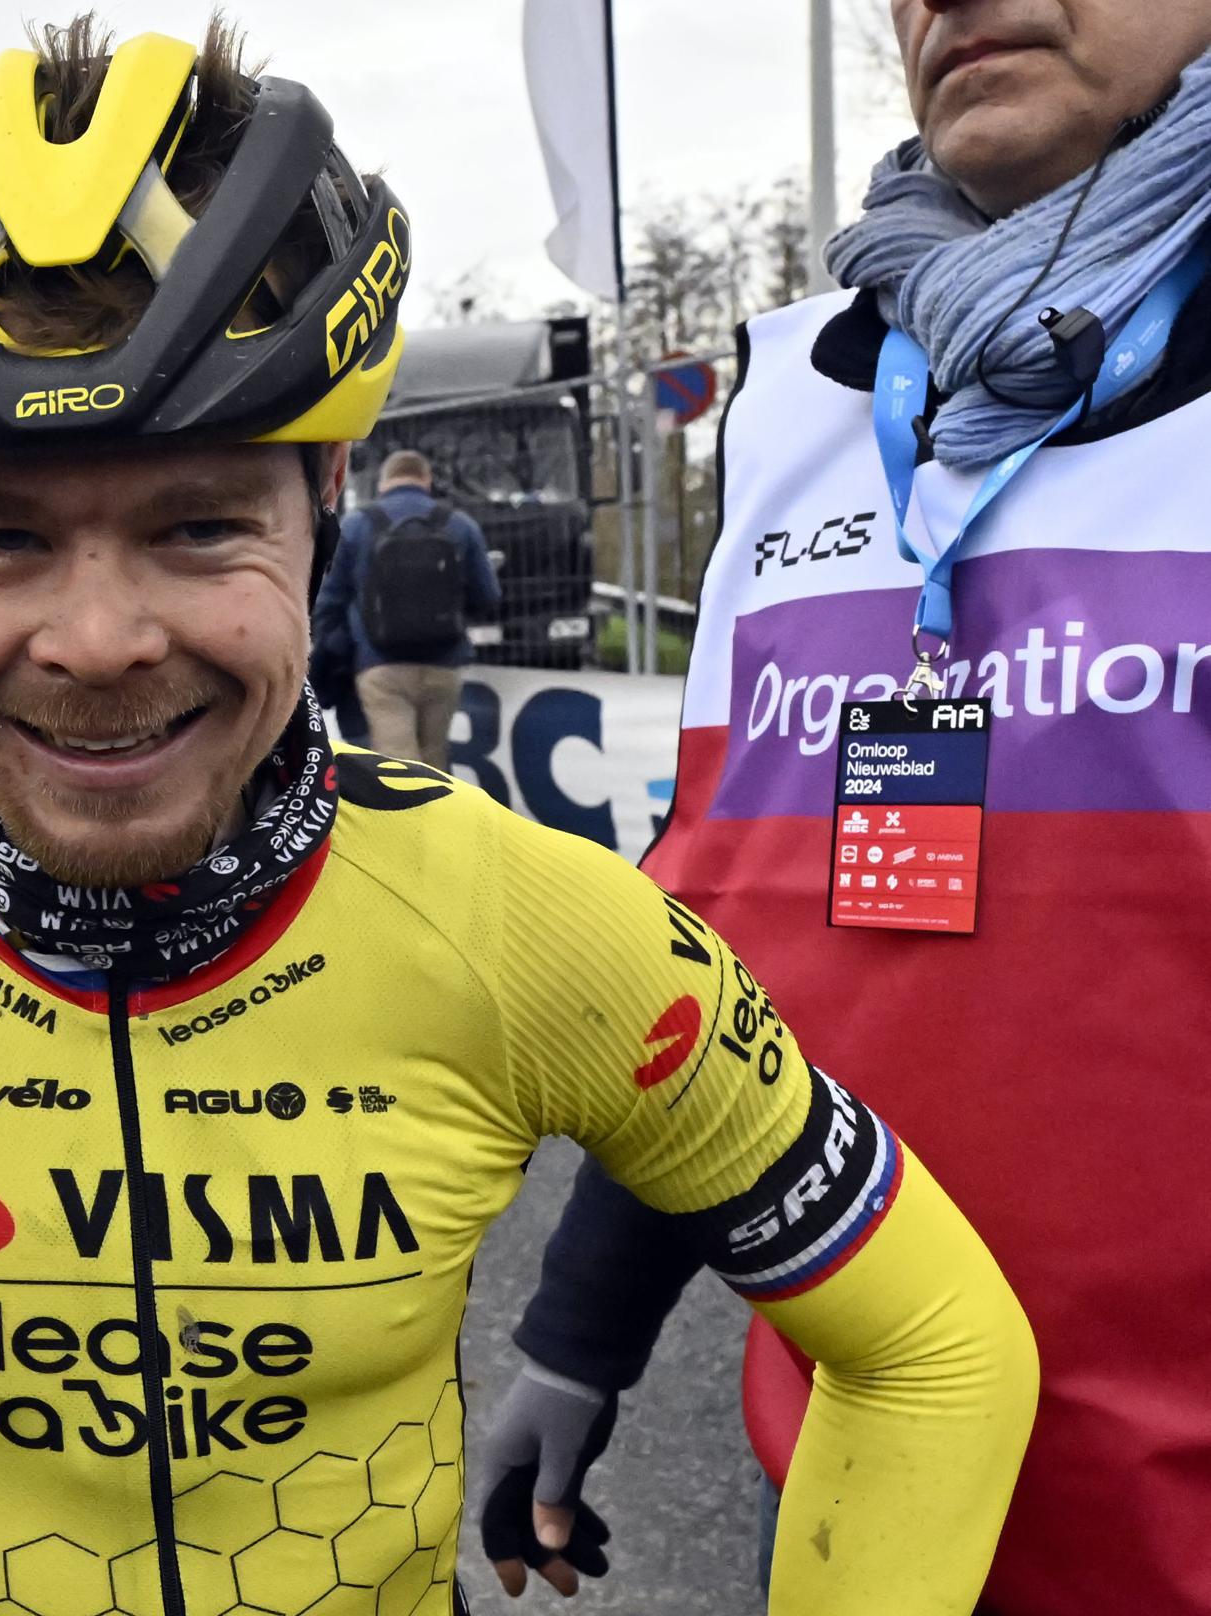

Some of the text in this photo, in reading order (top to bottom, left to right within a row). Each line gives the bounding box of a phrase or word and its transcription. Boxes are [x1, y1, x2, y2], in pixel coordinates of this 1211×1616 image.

[325, 207, 412, 378] GIRO
[16, 383, 125, 418] GIRO
[755, 511, 877, 577] FLCS
[932, 704, 984, 729] AA
[446, 680, 619, 851] BC
[846, 760, 935, 776] Nieuwsblad
[847, 742, 908, 760] Omloop
[845, 779, 882, 794] 2024
[275, 797, 334, 863] VISMA
[158, 998, 247, 1047] lease
[164, 1089, 263, 1114] AGU
[49, 1168, 420, 1263] VISMA
